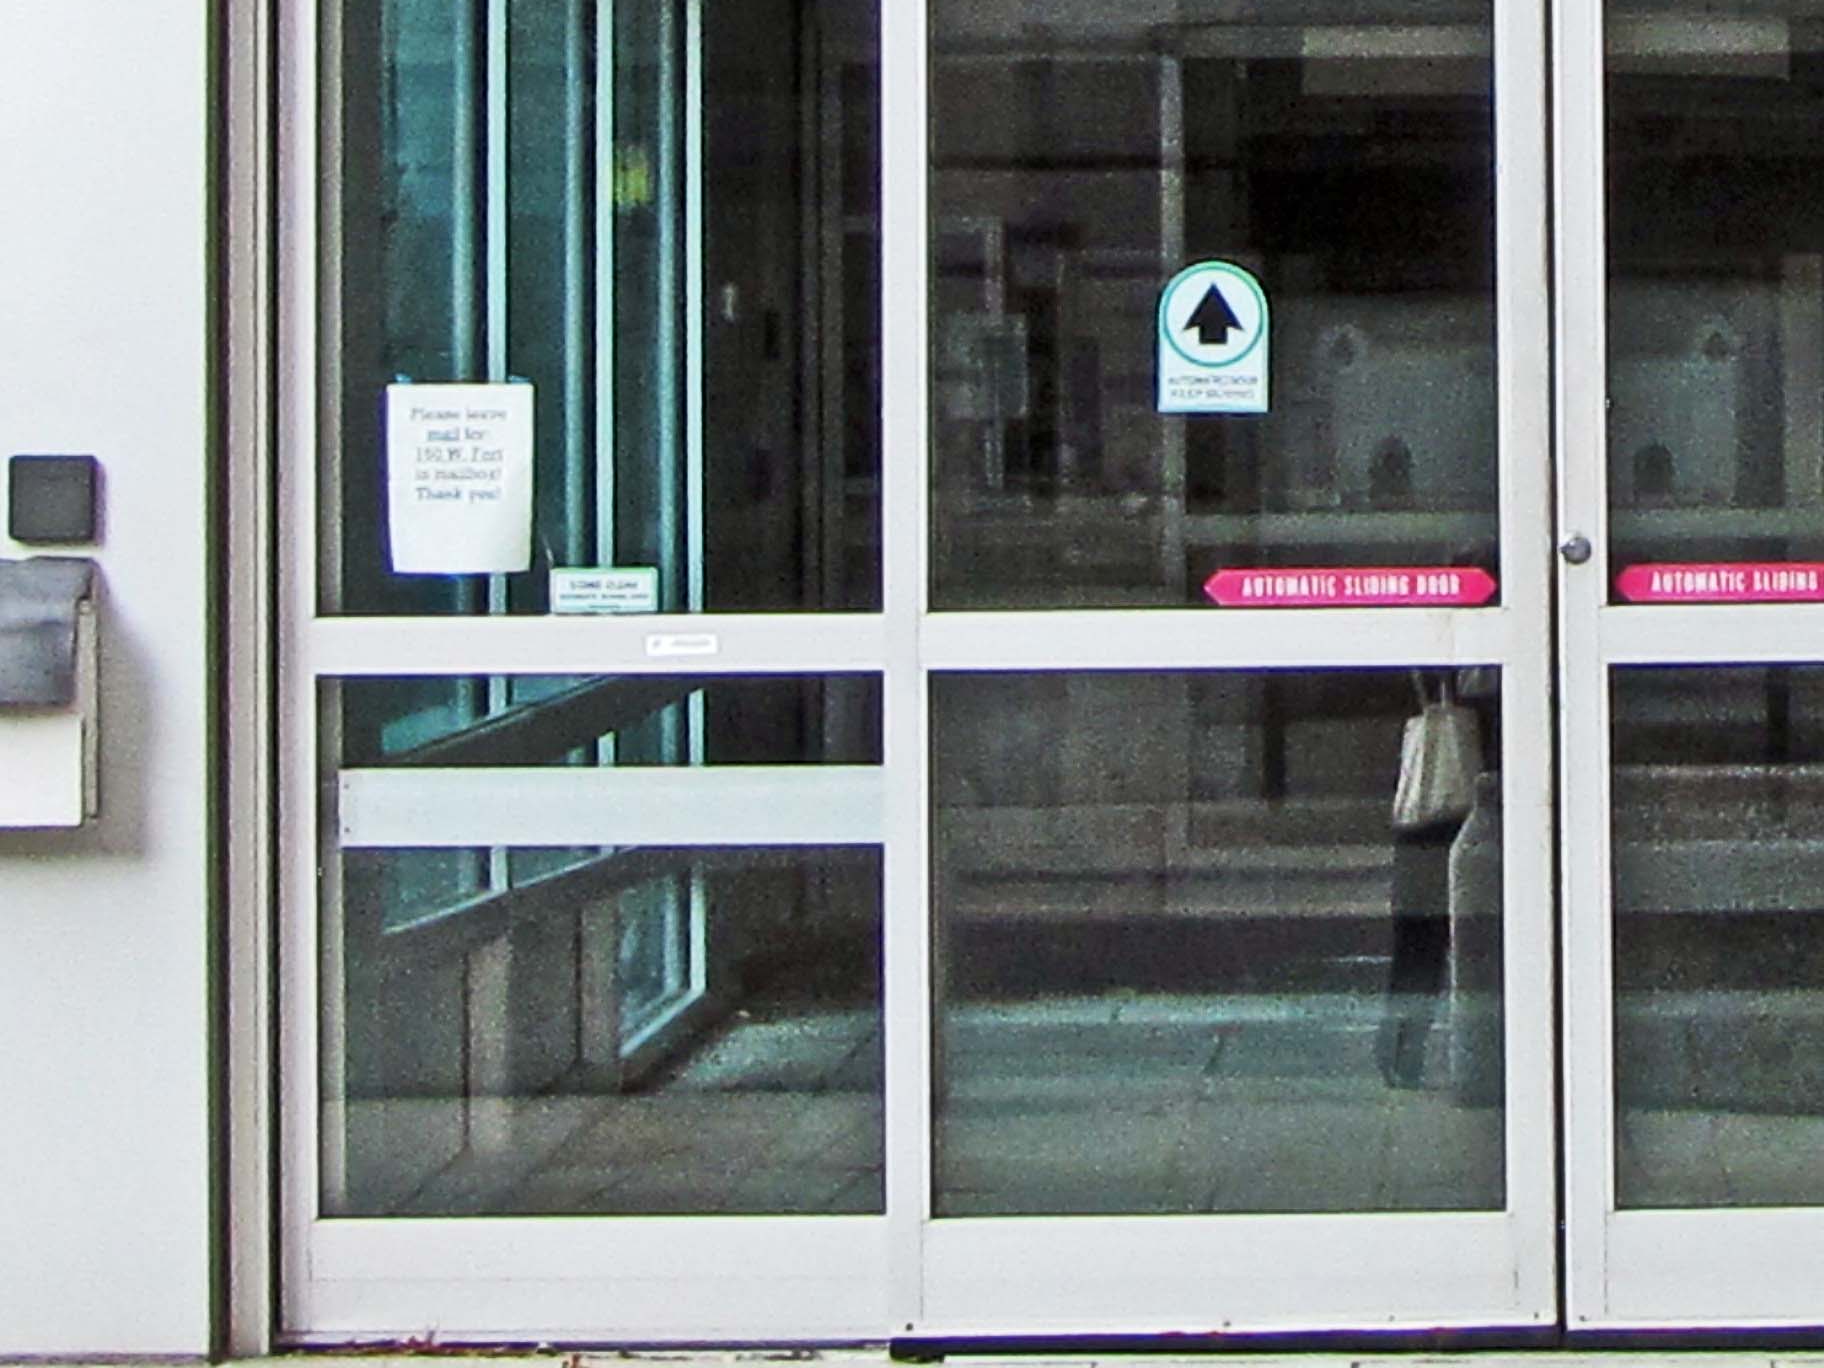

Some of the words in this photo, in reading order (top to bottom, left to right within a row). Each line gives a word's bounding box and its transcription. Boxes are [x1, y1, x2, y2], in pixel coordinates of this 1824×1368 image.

[1242, 575, 1336, 597] AUTOMATIC
[1344, 574, 1410, 596] SLIDING
[1416, 573, 1460, 596] DOOR
[1651, 570, 1745, 593] AUTOMATIC
